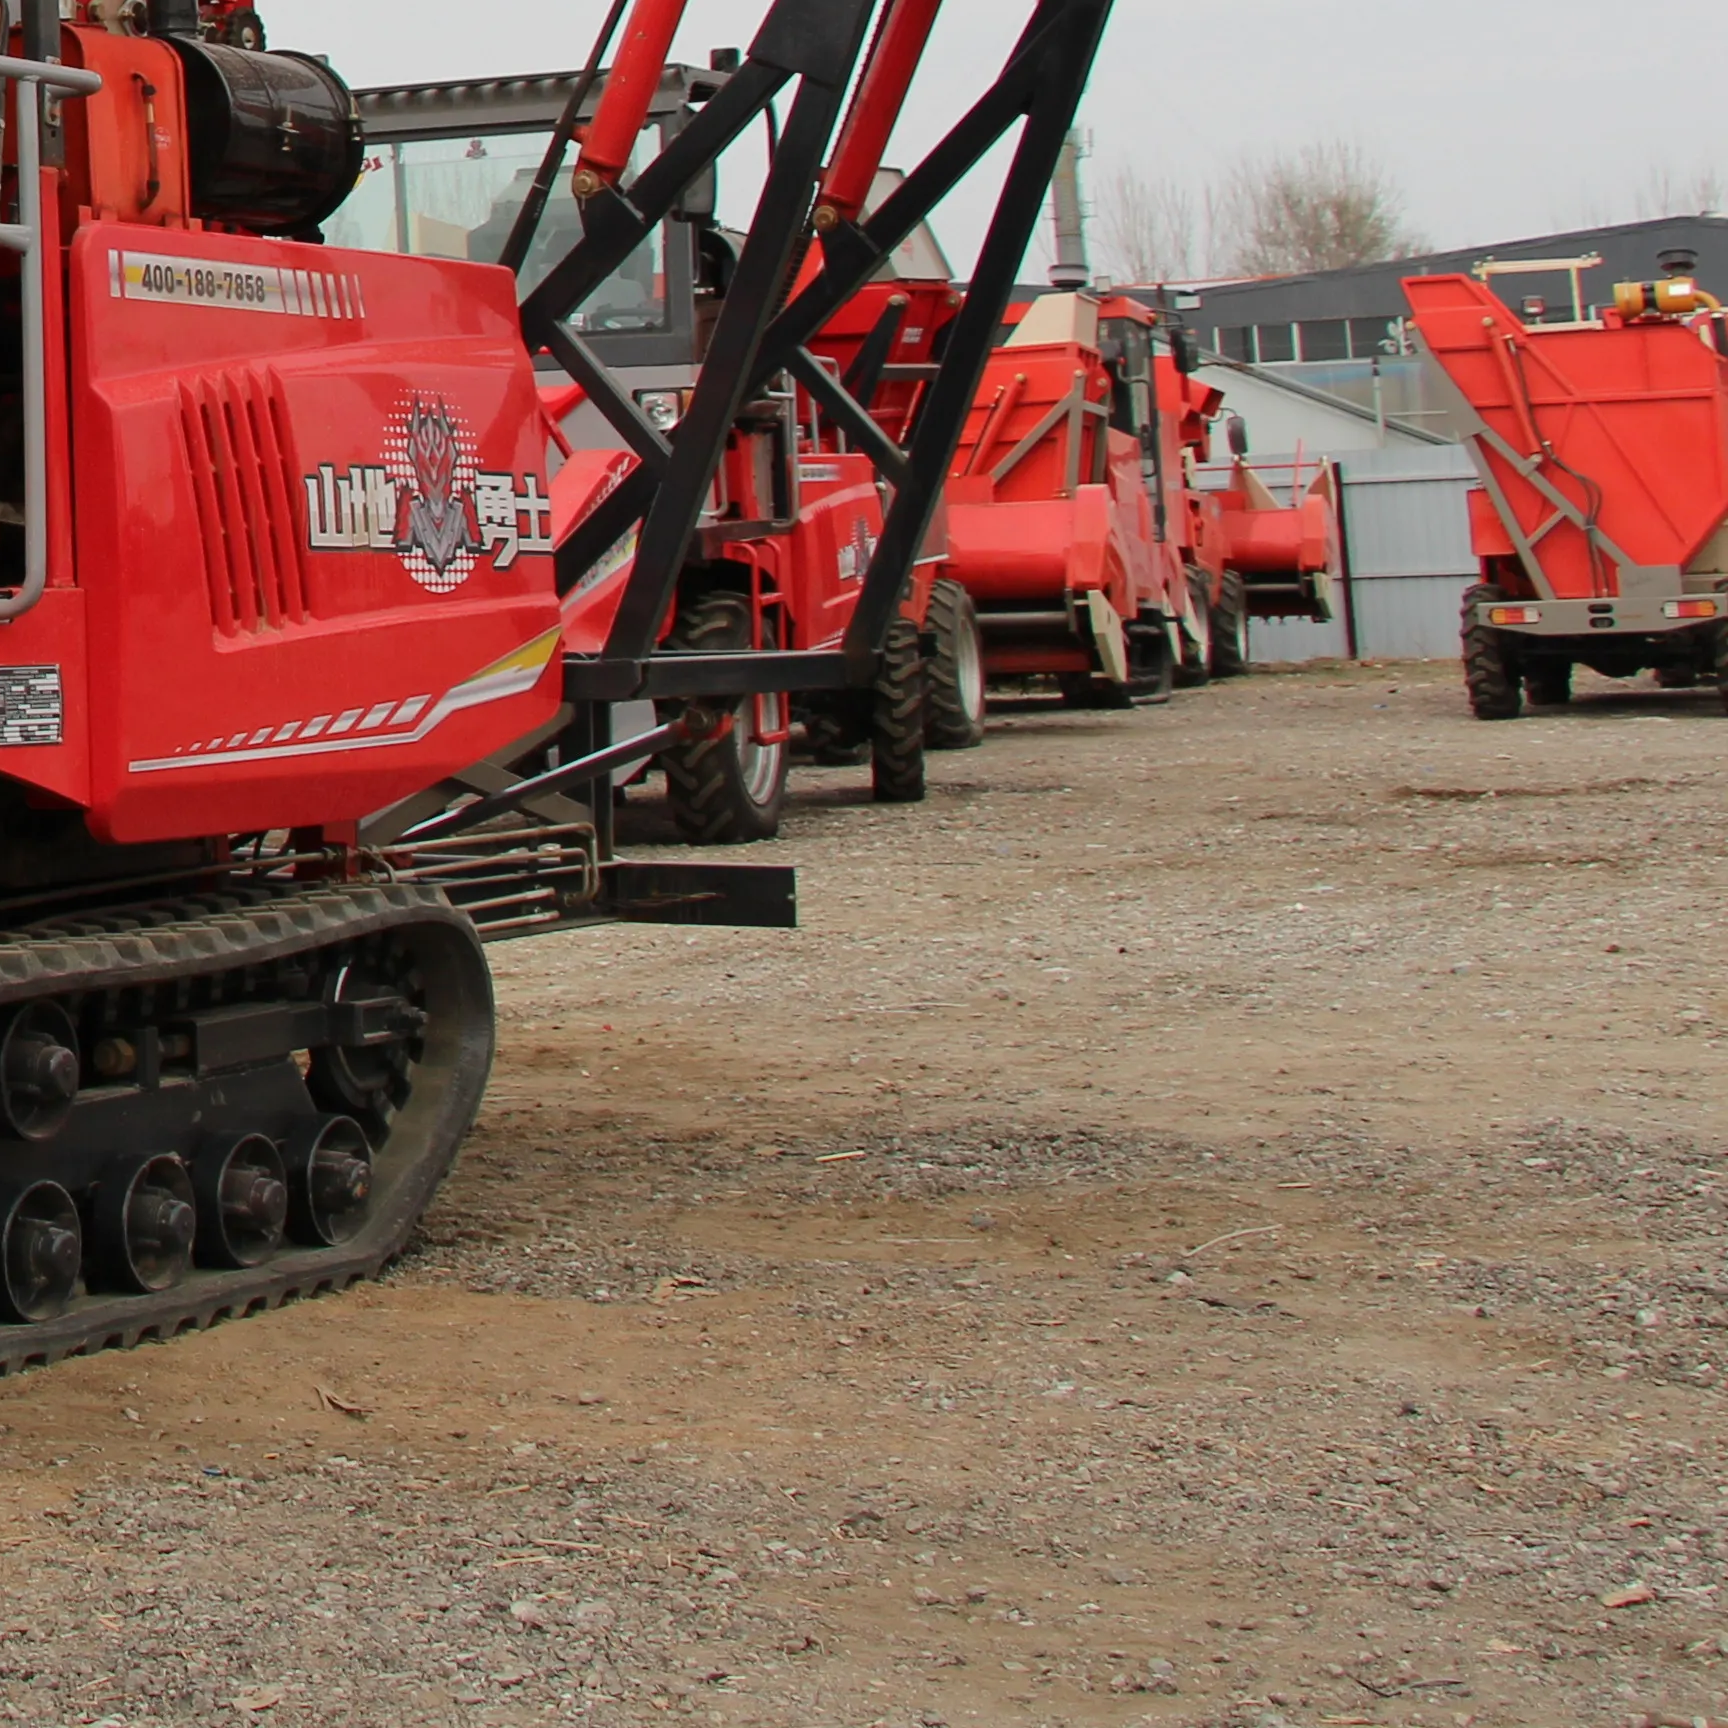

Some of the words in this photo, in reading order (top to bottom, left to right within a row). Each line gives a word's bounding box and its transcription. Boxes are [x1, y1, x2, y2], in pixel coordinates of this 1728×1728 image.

[142, 263, 266, 304] 400-188-7858
[304, 464, 396, 548] 山地
[476, 472, 554, 568] 勇士
